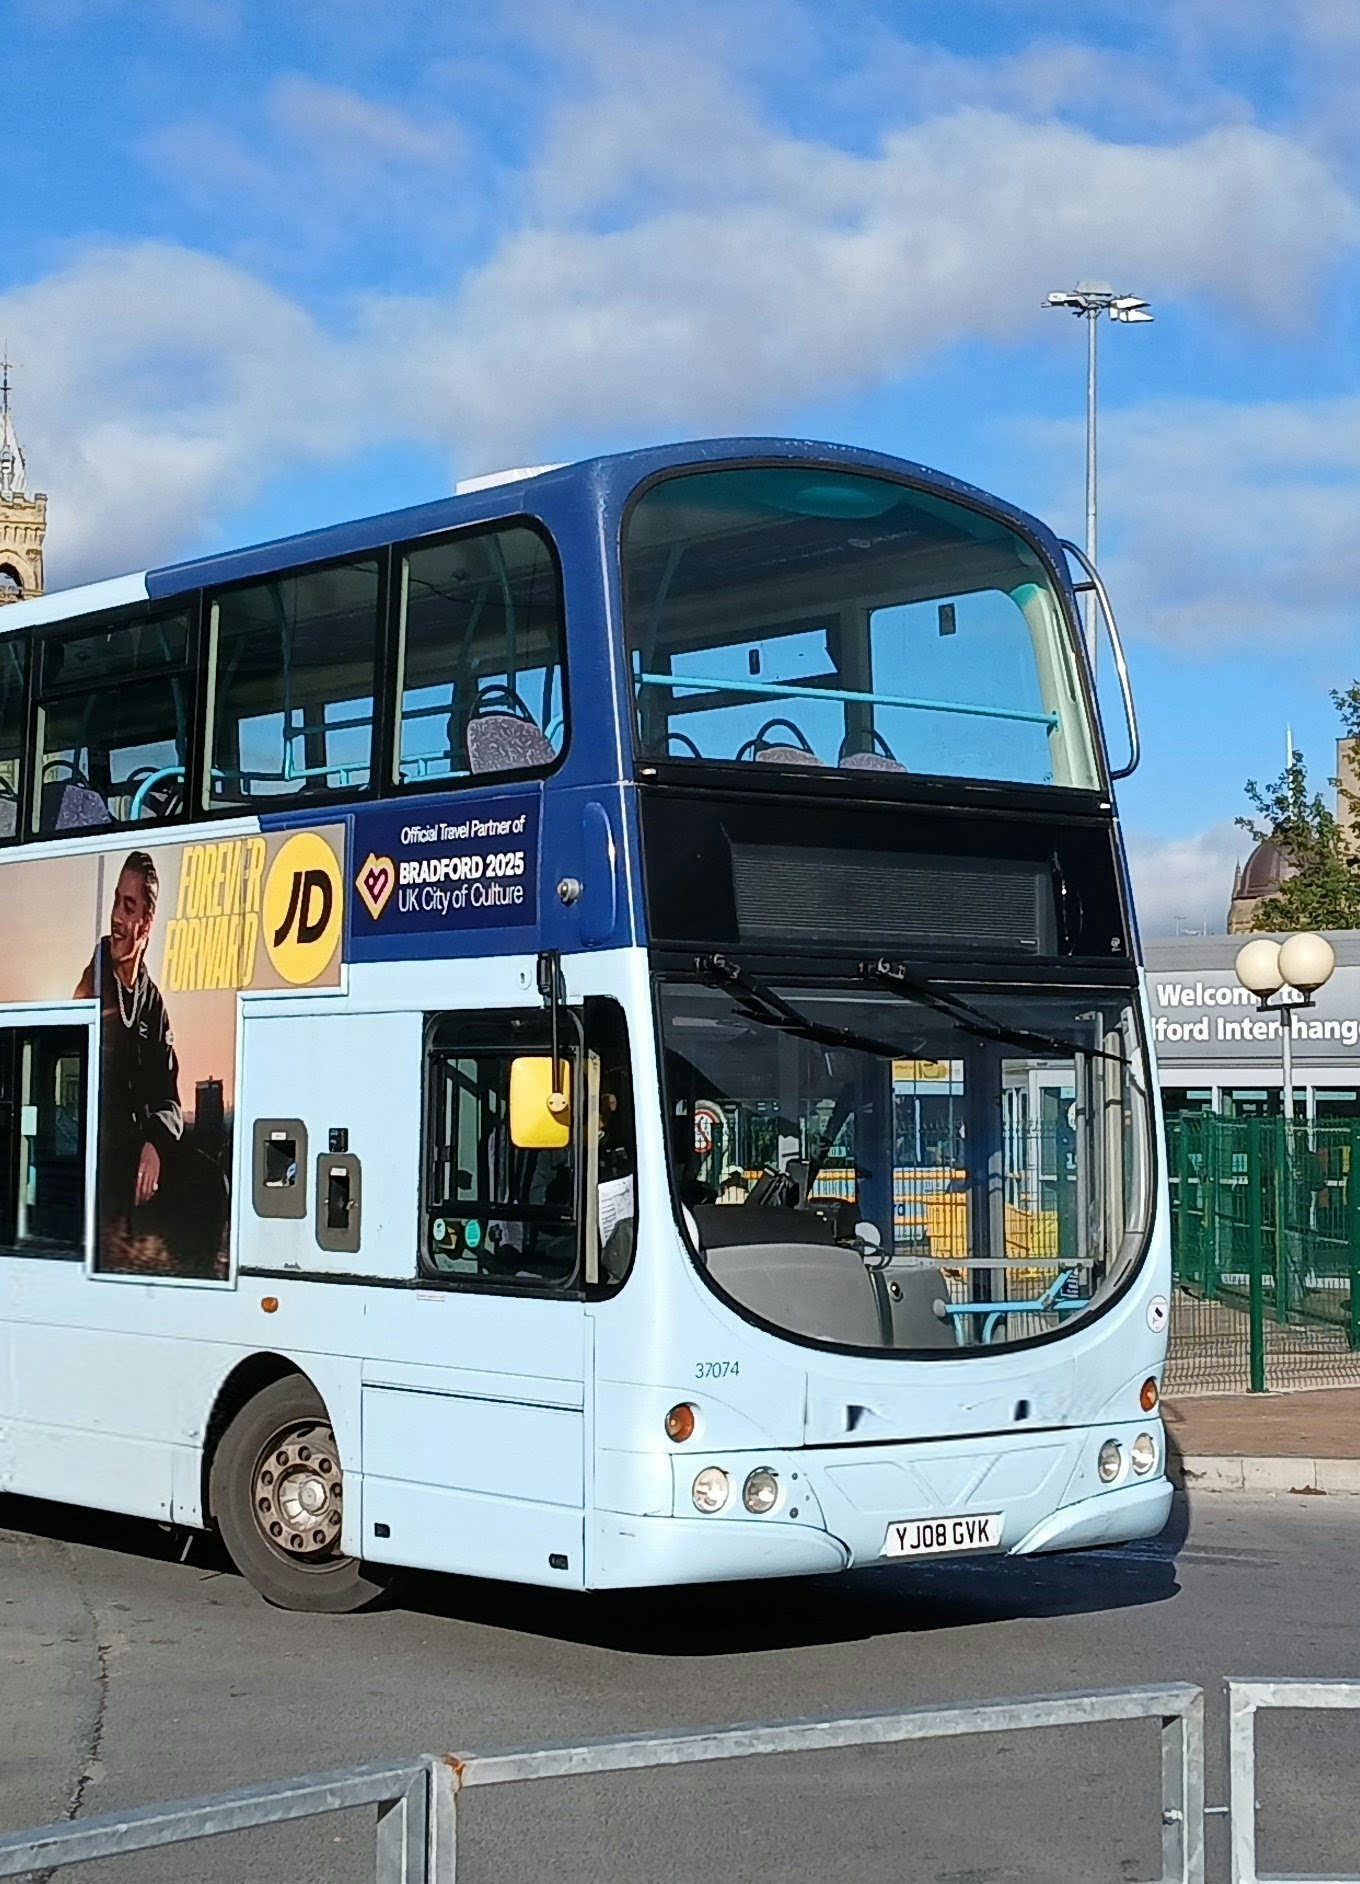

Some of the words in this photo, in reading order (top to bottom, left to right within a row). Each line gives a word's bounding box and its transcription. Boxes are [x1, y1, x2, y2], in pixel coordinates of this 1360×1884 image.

[400, 824, 438, 845] Official
[440, 820, 470, 840] Travel
[470, 818, 510, 838] Partner
[513, 814, 526, 833] of
[176, 837, 266, 920] FOREVER
[399, 856, 483, 885] BRADFORD
[486, 851, 524, 877] 2025
[273, 869, 333, 948] JD
[398, 888, 420, 912] UK
[422, 886, 449, 915] City
[452, 884, 468, 909] of
[470, 882, 523, 905] Culture
[160, 913, 259, 992] FORWARD
[695, 1361, 740, 1379] 37074
[896, 1523, 947, 1551] YJ08
[952, 1518, 990, 1545] GVK
